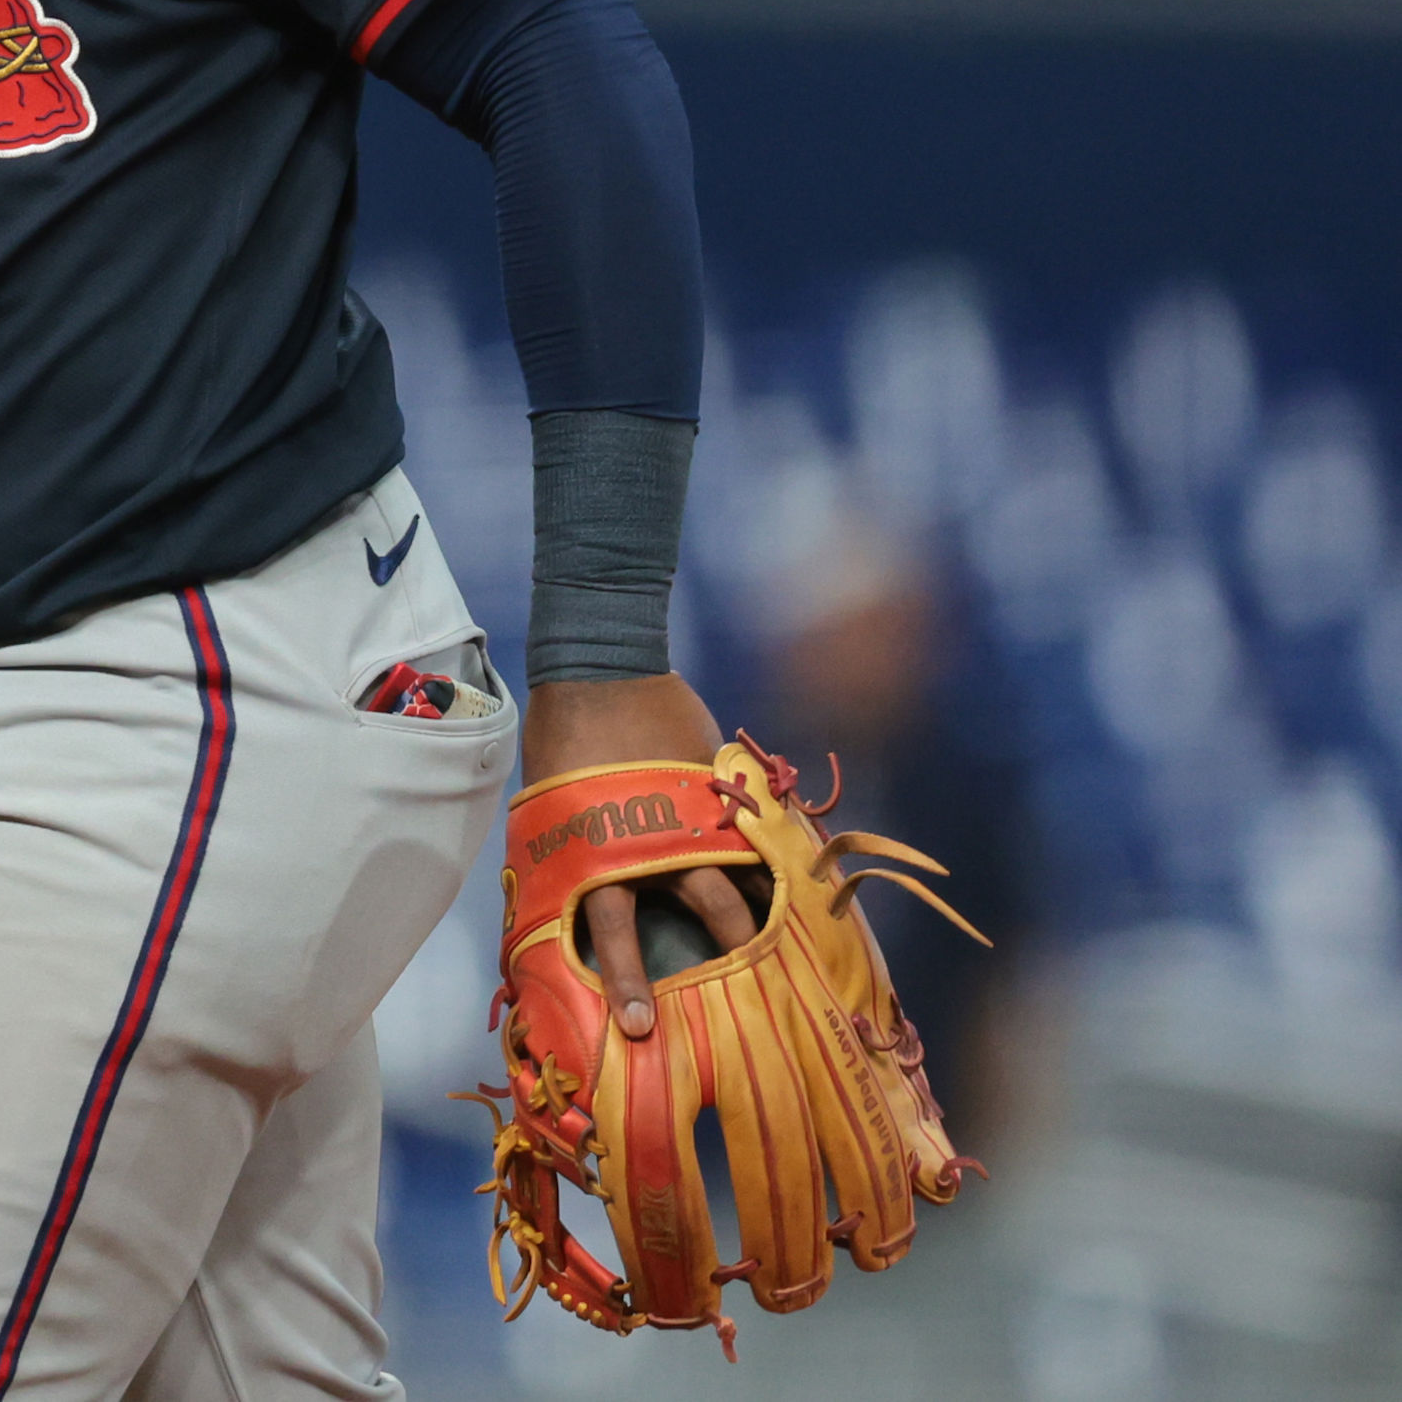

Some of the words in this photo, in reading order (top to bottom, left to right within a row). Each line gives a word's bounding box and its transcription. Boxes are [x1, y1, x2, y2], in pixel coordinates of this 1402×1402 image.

[526, 792, 684, 865] Wilson
[823, 1006, 858, 1069] Lover
[854, 1066, 879, 1113] Dog
